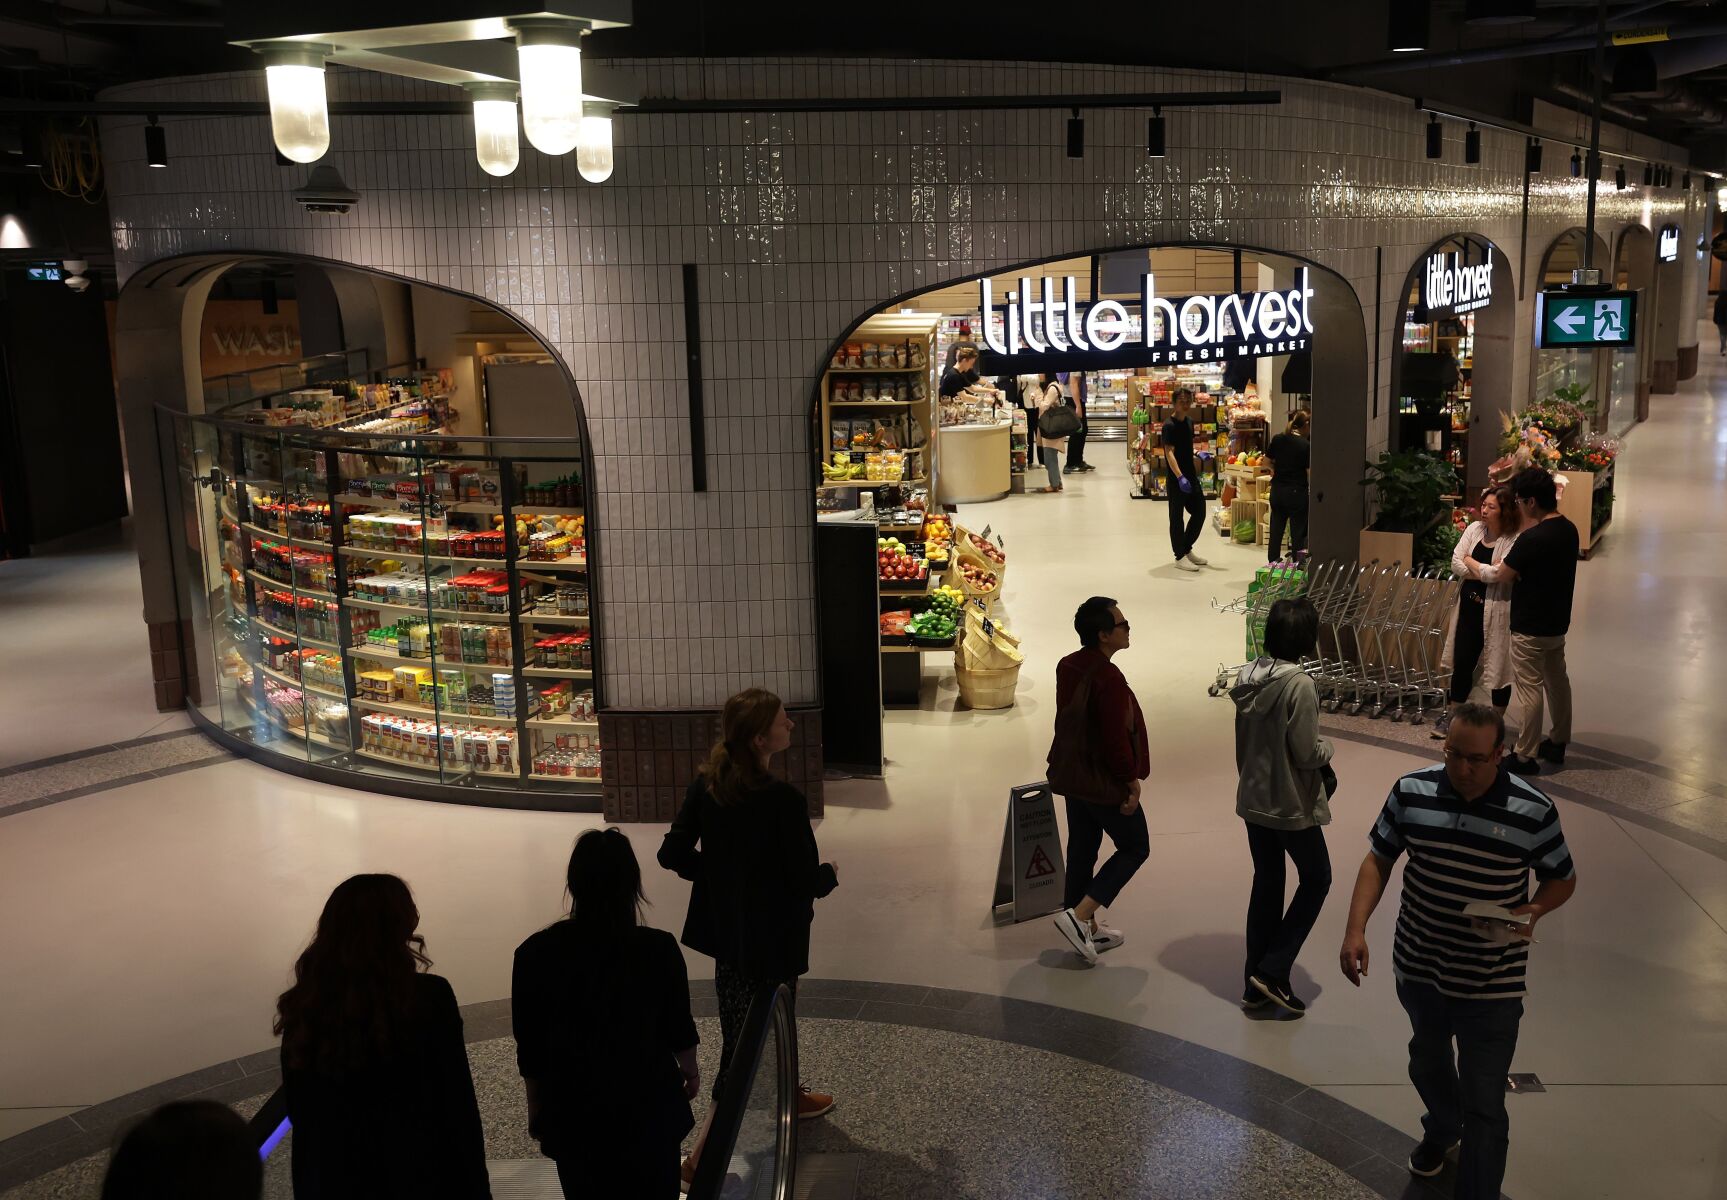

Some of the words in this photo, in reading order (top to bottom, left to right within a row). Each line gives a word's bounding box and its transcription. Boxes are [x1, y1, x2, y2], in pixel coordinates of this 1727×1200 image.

[1426, 253, 1453, 309] little
[1454, 247, 1493, 303] harvest
[980, 276, 1130, 355] little
[1145, 266, 1314, 348] harvest
[1152, 347, 1225, 363] FRESH
[1238, 339, 1306, 356] MARKET
